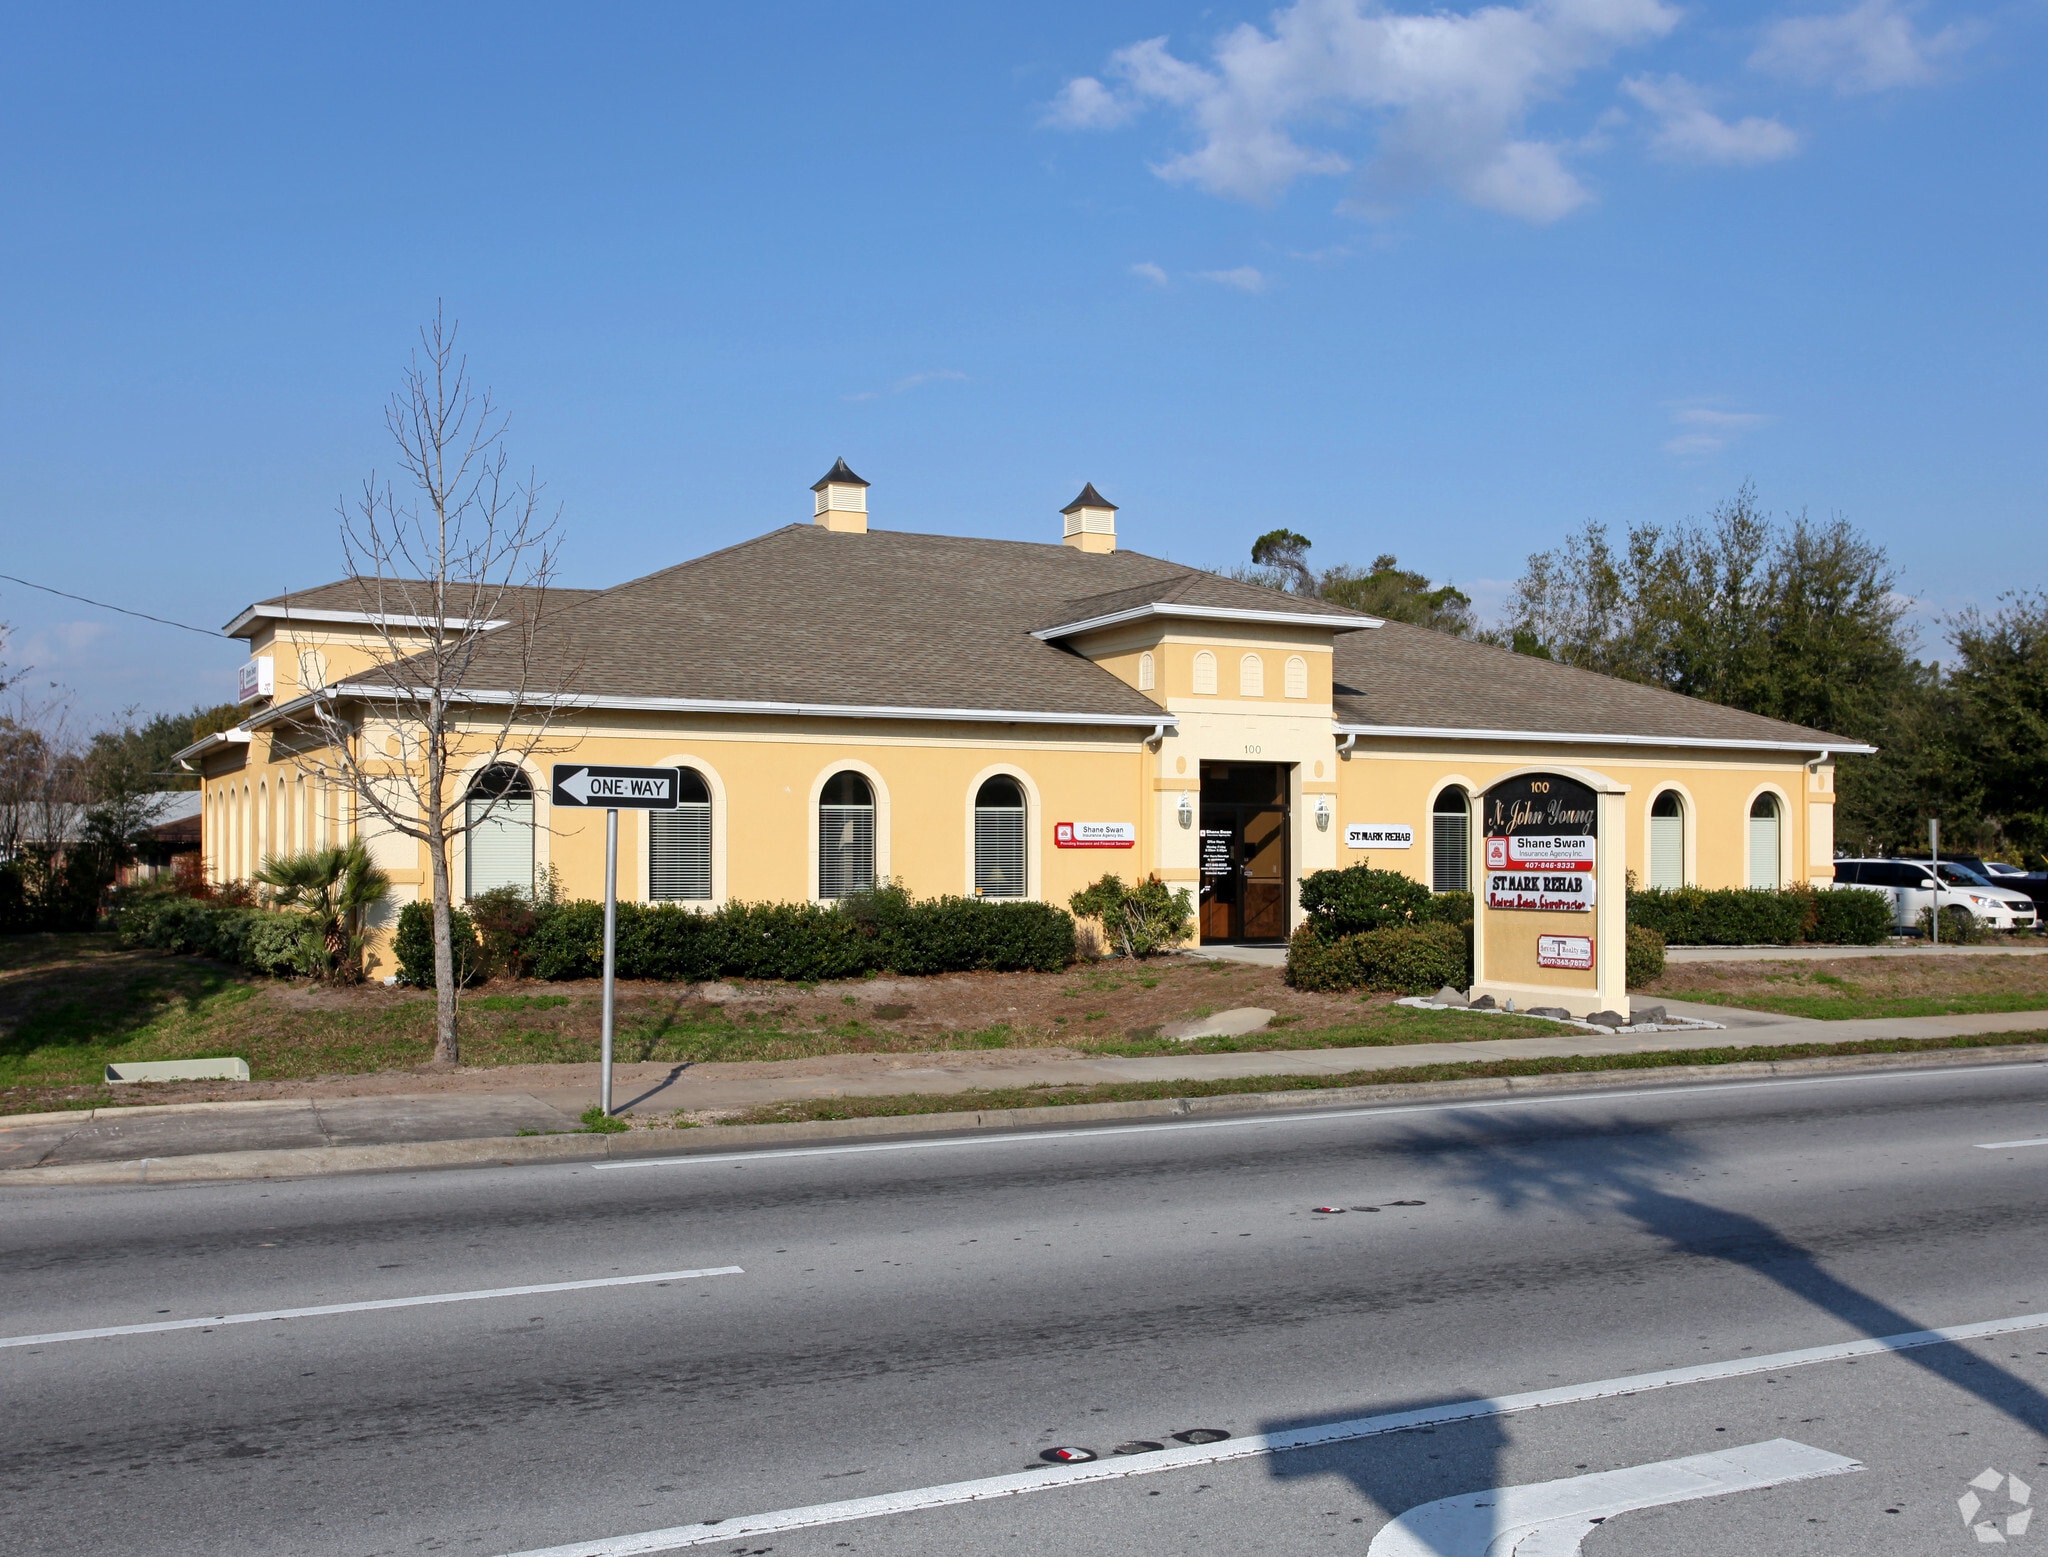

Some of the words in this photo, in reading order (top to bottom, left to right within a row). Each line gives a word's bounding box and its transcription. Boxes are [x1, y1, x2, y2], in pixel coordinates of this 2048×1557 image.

[1244, 745, 1262, 755] 100
[590, 778, 624, 795] ONE
[630, 780, 665, 797] WAY
[1531, 782, 1550, 793] 100
[1505, 799, 1545, 835] John
[1547, 799, 1594, 836] Young
[1385, 832, 1411, 842] REHAB
[1517, 838, 1551, 848] Shane
[1554, 837, 1585, 848] Swan
[1550, 851, 1572, 859] Agency
[1543, 877, 1583, 892] REHAB
